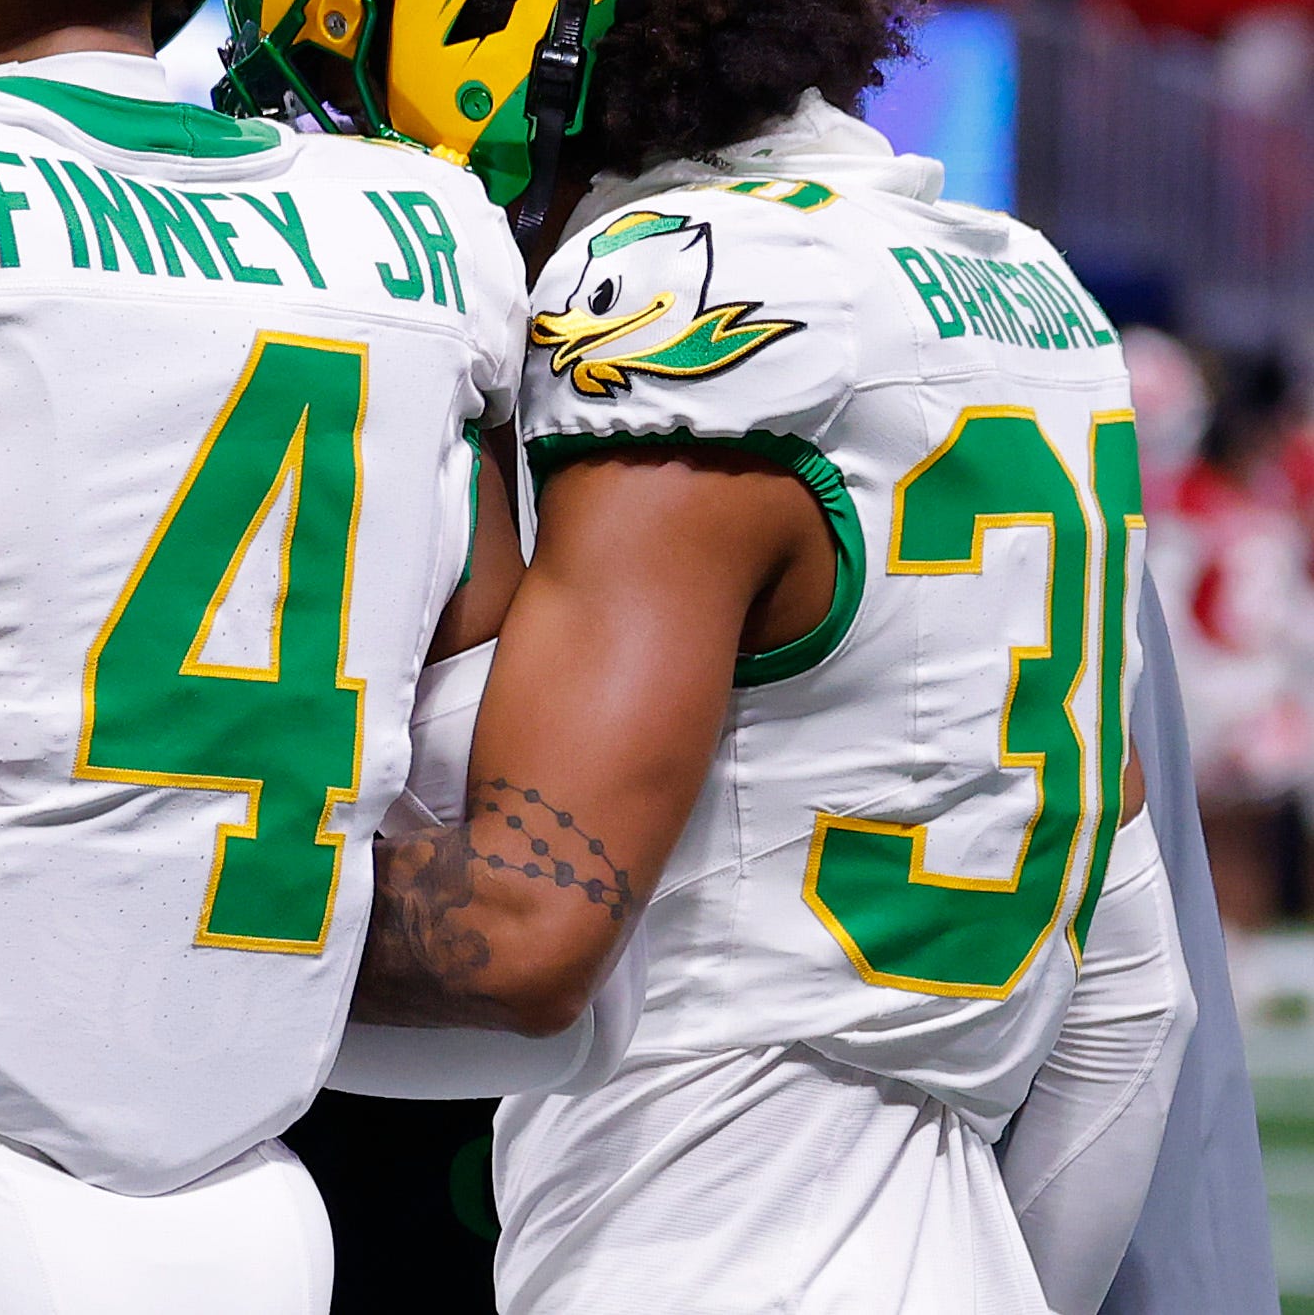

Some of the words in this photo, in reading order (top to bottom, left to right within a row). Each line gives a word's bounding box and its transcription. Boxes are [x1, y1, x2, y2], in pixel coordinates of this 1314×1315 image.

[363, 190, 467, 315] JR
[887, 245, 1123, 351] BARKSDAL
[72, 328, 370, 955] 4
